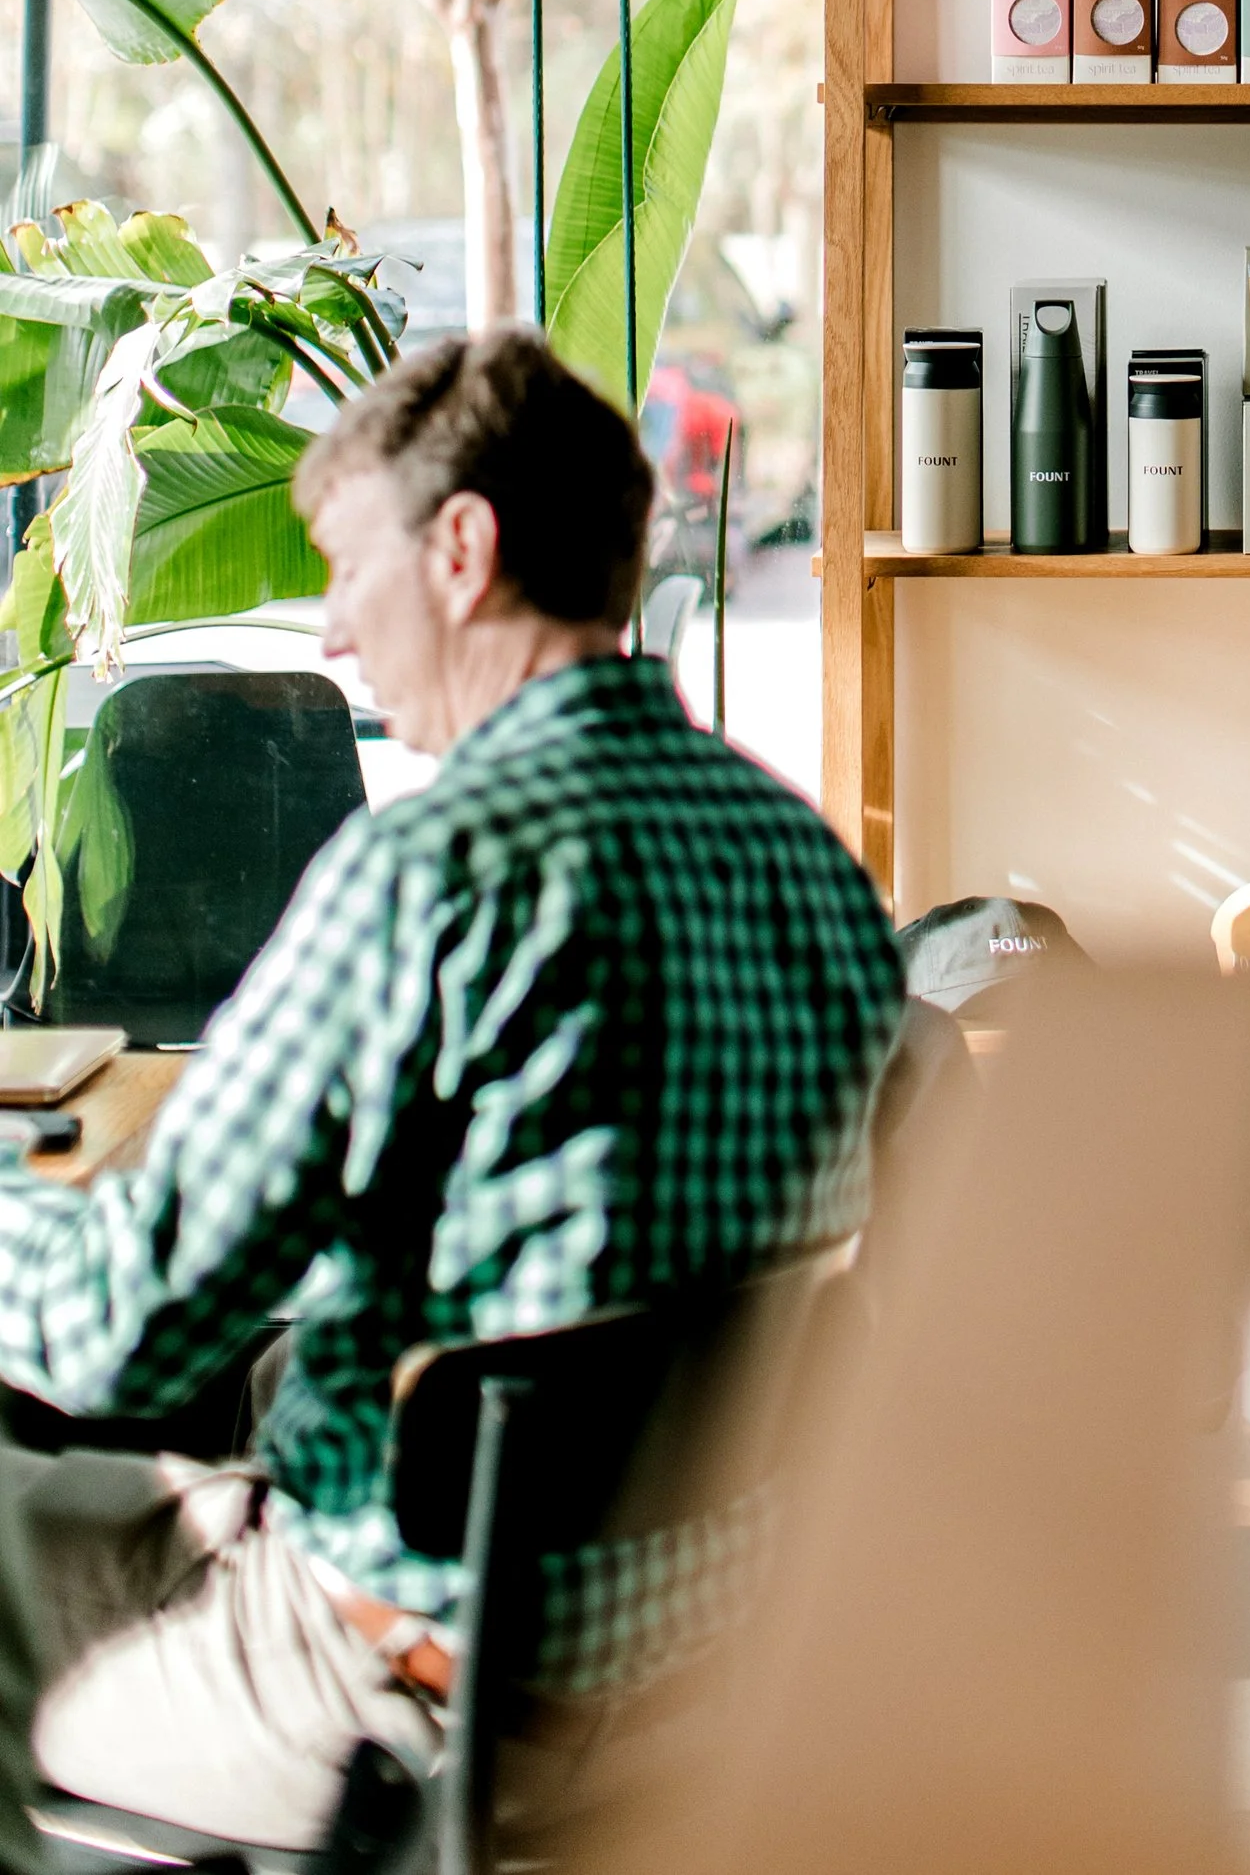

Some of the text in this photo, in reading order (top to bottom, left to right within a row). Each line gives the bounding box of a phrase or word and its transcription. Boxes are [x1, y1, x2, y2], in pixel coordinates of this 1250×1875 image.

[1007, 63, 1055, 77] spirit tea
[1088, 63, 1136, 77] spirit tea
[1173, 65, 1221, 76] spirit tea
[918, 456, 958, 466] FOUNT
[1143, 466, 1184, 475] FOUNT
[1029, 472, 1070, 482] FOUNT
